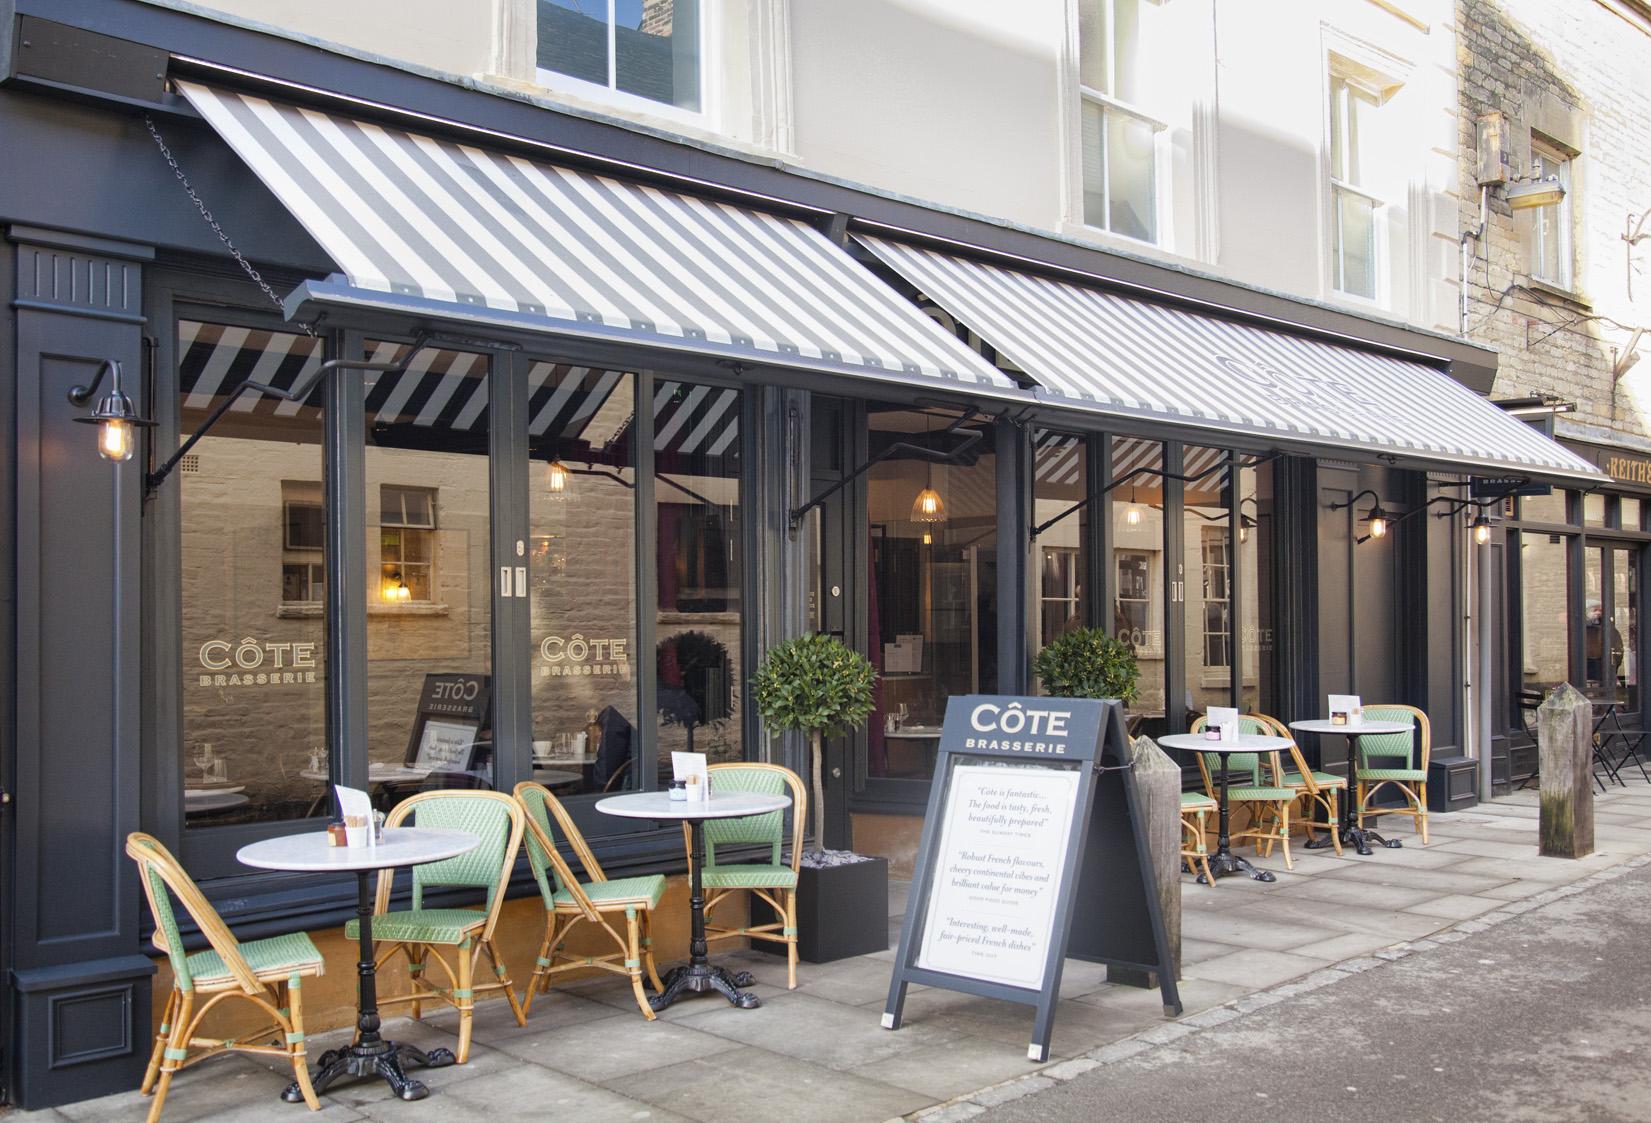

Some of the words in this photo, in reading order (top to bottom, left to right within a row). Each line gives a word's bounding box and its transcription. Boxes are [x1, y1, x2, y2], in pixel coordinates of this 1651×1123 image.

[200, 636, 315, 670] CÔTE
[541, 633, 627, 662] CÔTE
[541, 664, 628, 677] BRASSERIE
[200, 671, 316, 687] BRASSERIE
[970, 701, 1072, 737] CÔTE
[965, 738, 1066, 754] BRASSERIE
[969, 799, 981, 809] The
[982, 800, 1001, 811] food
[968, 812, 1008, 827] beautifully
[987, 853, 1012, 865] French
[973, 868, 1015, 879] continental
[1034, 873, 1050, 883] and
[951, 877, 980, 889] brilliant
[1001, 883, 1013, 895] for
[982, 935, 1007, 948] French
